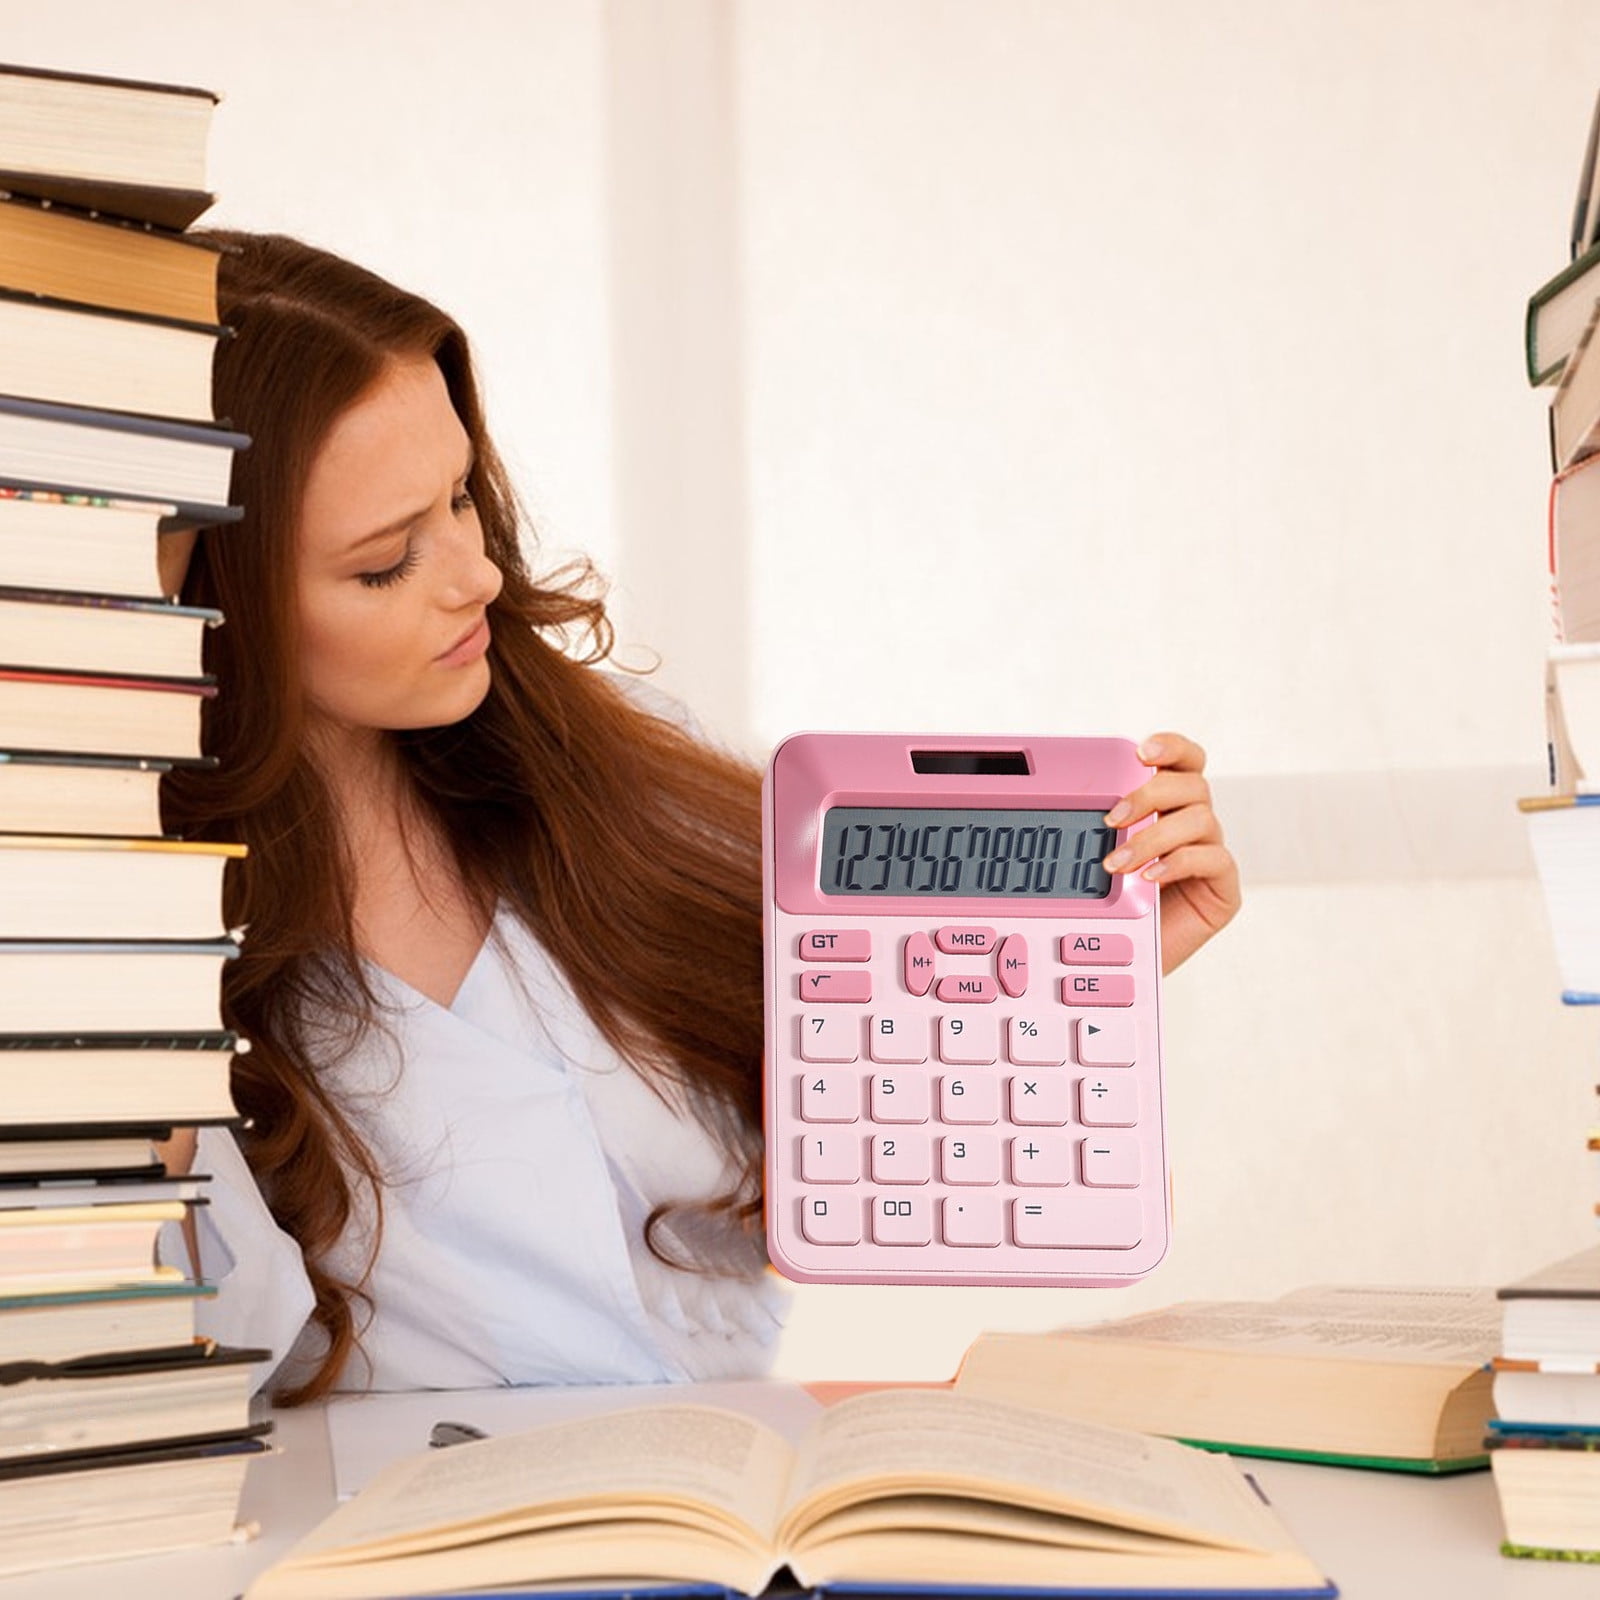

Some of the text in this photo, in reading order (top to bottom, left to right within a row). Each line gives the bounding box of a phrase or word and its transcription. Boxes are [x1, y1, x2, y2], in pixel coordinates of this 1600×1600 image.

[811, 934, 839, 949] GT
[951, 933, 985, 946] MRC
[1073, 937, 1101, 951] AC
[912, 957, 933, 968] M+
[958, 981, 982, 993] MU
[1074, 977, 1099, 992] CE
[812, 1018, 825, 1034] 7
[881, 1019, 894, 1035] 8
[950, 1020, 963, 1035] 9
[812, 1079, 826, 1095] 4
[882, 1079, 895, 1095] 5
[951, 1080, 964, 1096] 6
[816, 1141, 823, 1156] 1
[883, 1140, 896, 1156] 2
[953, 1142, 966, 1158] 3
[814, 1200, 827, 1216] 0
[883, 1200, 912, 1216] 00
